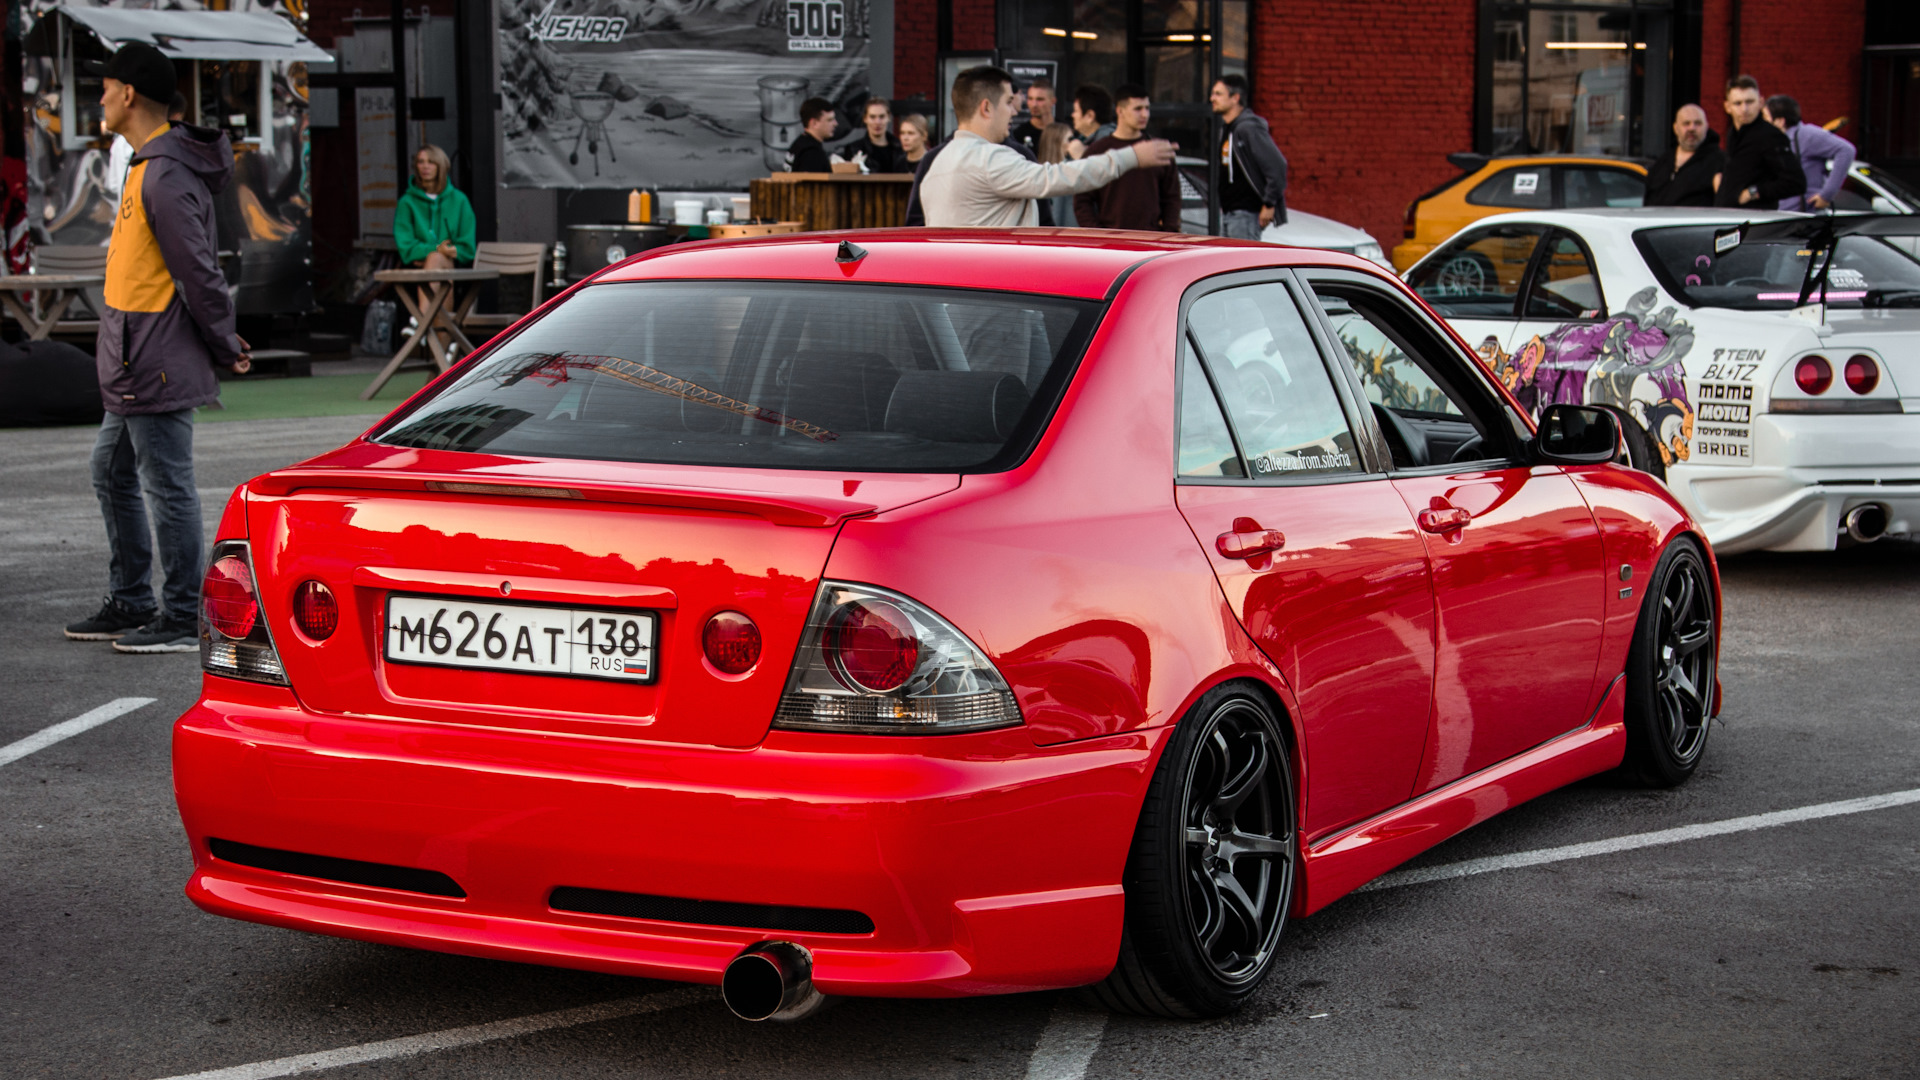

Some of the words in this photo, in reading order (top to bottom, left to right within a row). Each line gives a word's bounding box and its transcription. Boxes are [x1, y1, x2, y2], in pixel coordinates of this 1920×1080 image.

[786, 0, 845, 39] JOG
[1727, 349, 1766, 361] TEIN
[1699, 404, 1749, 423] MOTUL
[1698, 426, 1722, 436] TOYO
[1723, 428, 1749, 438] TIRES
[1698, 442, 1750, 458] BRIDE
[1254, 448, 1351, 473] @altezza.from.siberia
[577, 617, 640, 657] 138
[590, 656, 622, 673] RUS
